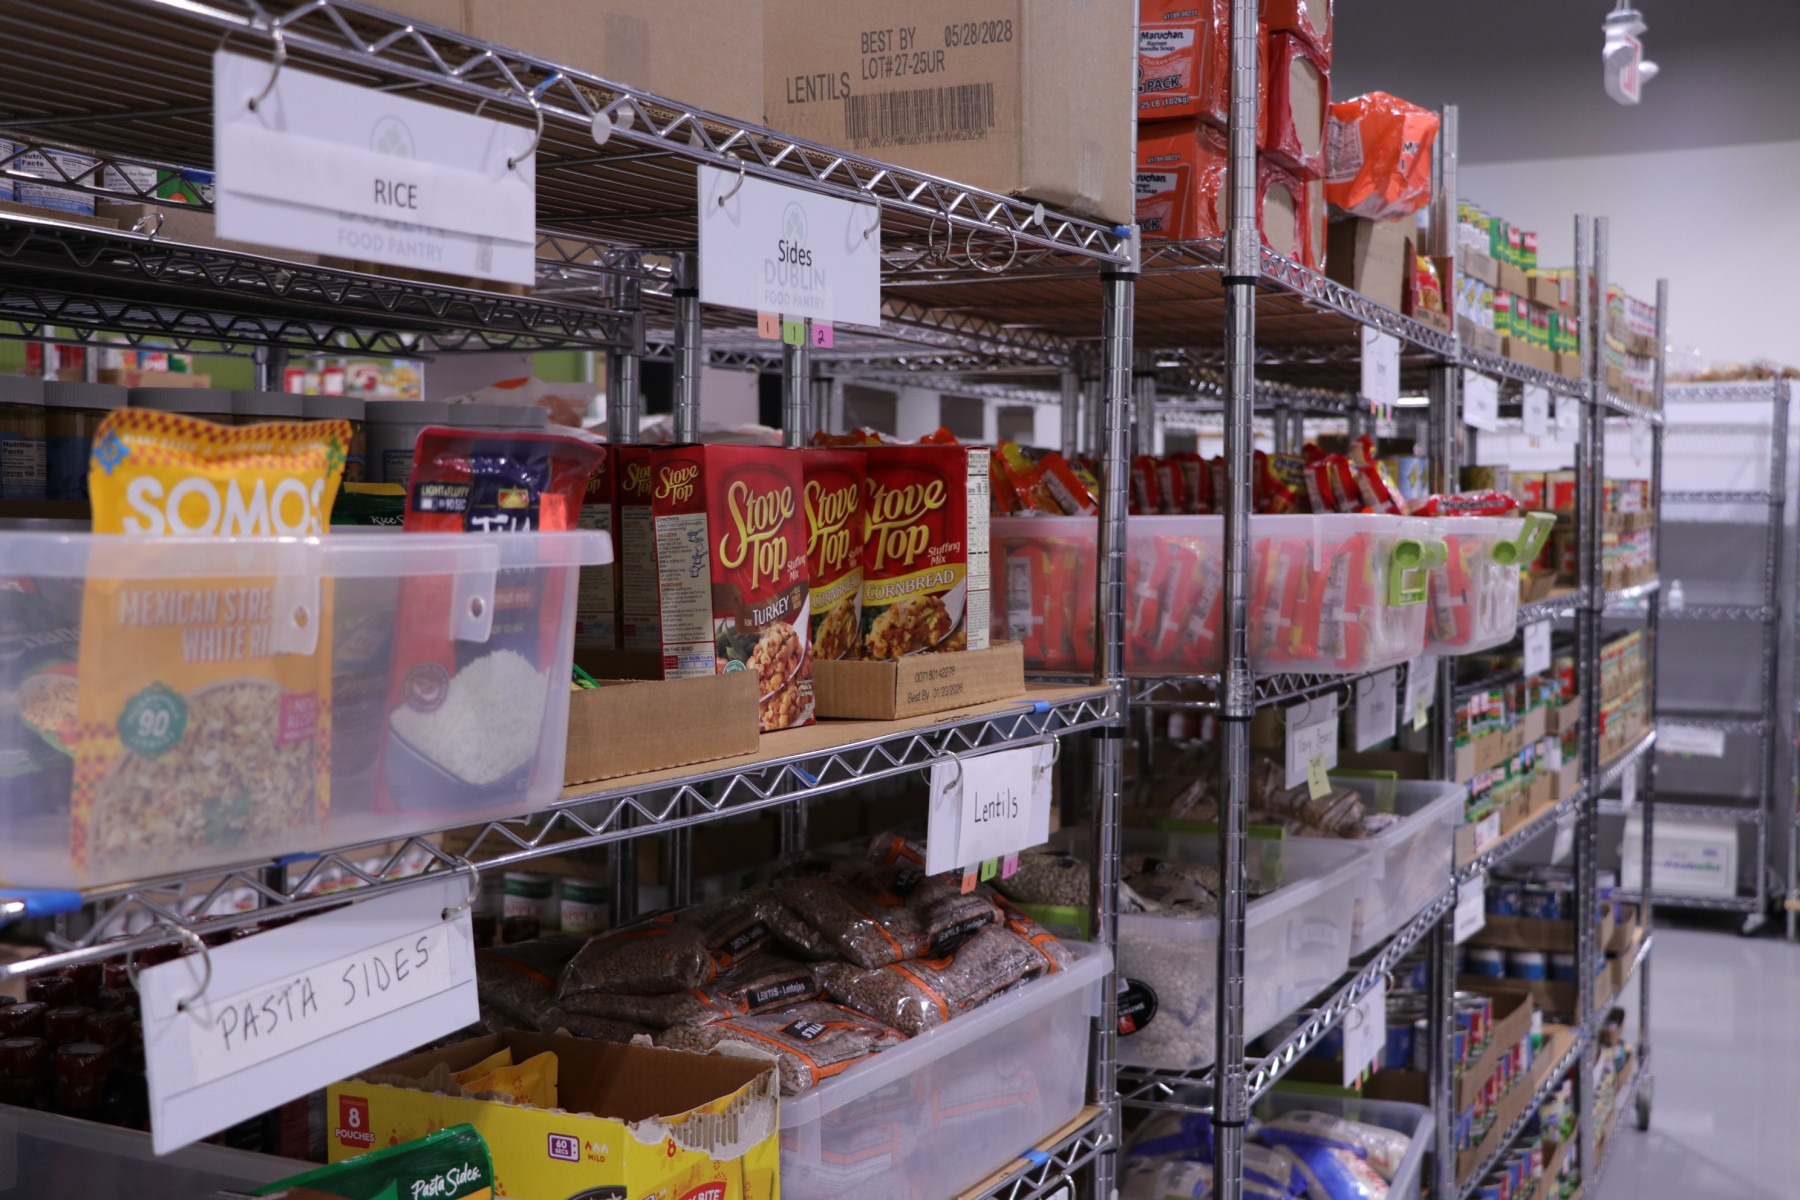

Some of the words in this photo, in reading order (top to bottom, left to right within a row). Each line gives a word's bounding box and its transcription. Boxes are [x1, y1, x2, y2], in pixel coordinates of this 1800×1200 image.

[861, 29, 894, 54] BEST
[900, 27, 917, 50] BY
[945, 19, 1013, 47] 05/28/2028
[1141, 30, 1184, 40] Maruchan
[786, 72, 850, 104] LENTILS
[1146, 74, 1183, 93] PACK
[1152, 99, 1160, 108] LB
[374, 179, 418, 210] RICE
[338, 228, 384, 251] FOOD
[388, 237, 445, 263] PANTRY
[778, 239, 812, 267] Sides
[764, 258, 826, 292] DUBLIN
[764, 289, 790, 306] FOOD
[793, 294, 826, 311] PANTRY
[817, 330, 825, 343] 2
[421, 484, 444, 496] LIGHT
[655, 465, 699, 499] Stove
[670, 484, 694, 506] Top
[122, 476, 326, 536] SOMOS
[804, 480, 858, 556] Stove
[369, 515, 397, 526] Rice
[720, 481, 796, 569] Stove
[817, 528, 850, 578] Top
[871, 521, 930, 572] Top
[928, 541, 960, 559] Stuffing
[746, 533, 788, 590] Top
[787, 554, 806, 572] Stuffing
[789, 568, 799, 582] Mix
[930, 555, 946, 567] Mix
[813, 573, 860, 608] CORNBREAD
[866, 569, 954, 601] CORNBREAD
[119, 590, 219, 626] MEXICAN
[224, 587, 273, 623] STRE
[744, 617, 753, 627] FOR
[752, 594, 790, 627] TURKEY
[182, 626, 247, 664] WHITE
[908, 692, 920, 703] Best
[922, 689, 929, 703] By
[138, 709, 170, 737] 90
[974, 788, 1018, 823] Lentils
[216, 976, 318, 1051] PASTA
[343, 936, 429, 1006] SIDES
[757, 986, 779, 1002] LENTILS
[348, 1107, 361, 1128] 8
[335, 1128, 375, 1144] POUCHES
[555, 1139, 567, 1149] 60
[667, 1138, 677, 1158] 8
[555, 1148, 569, 1156] SECS
[588, 1153, 606, 1163] MILD
[411, 1175, 445, 1200] Pasta
[445, 1163, 481, 1196] Sides
